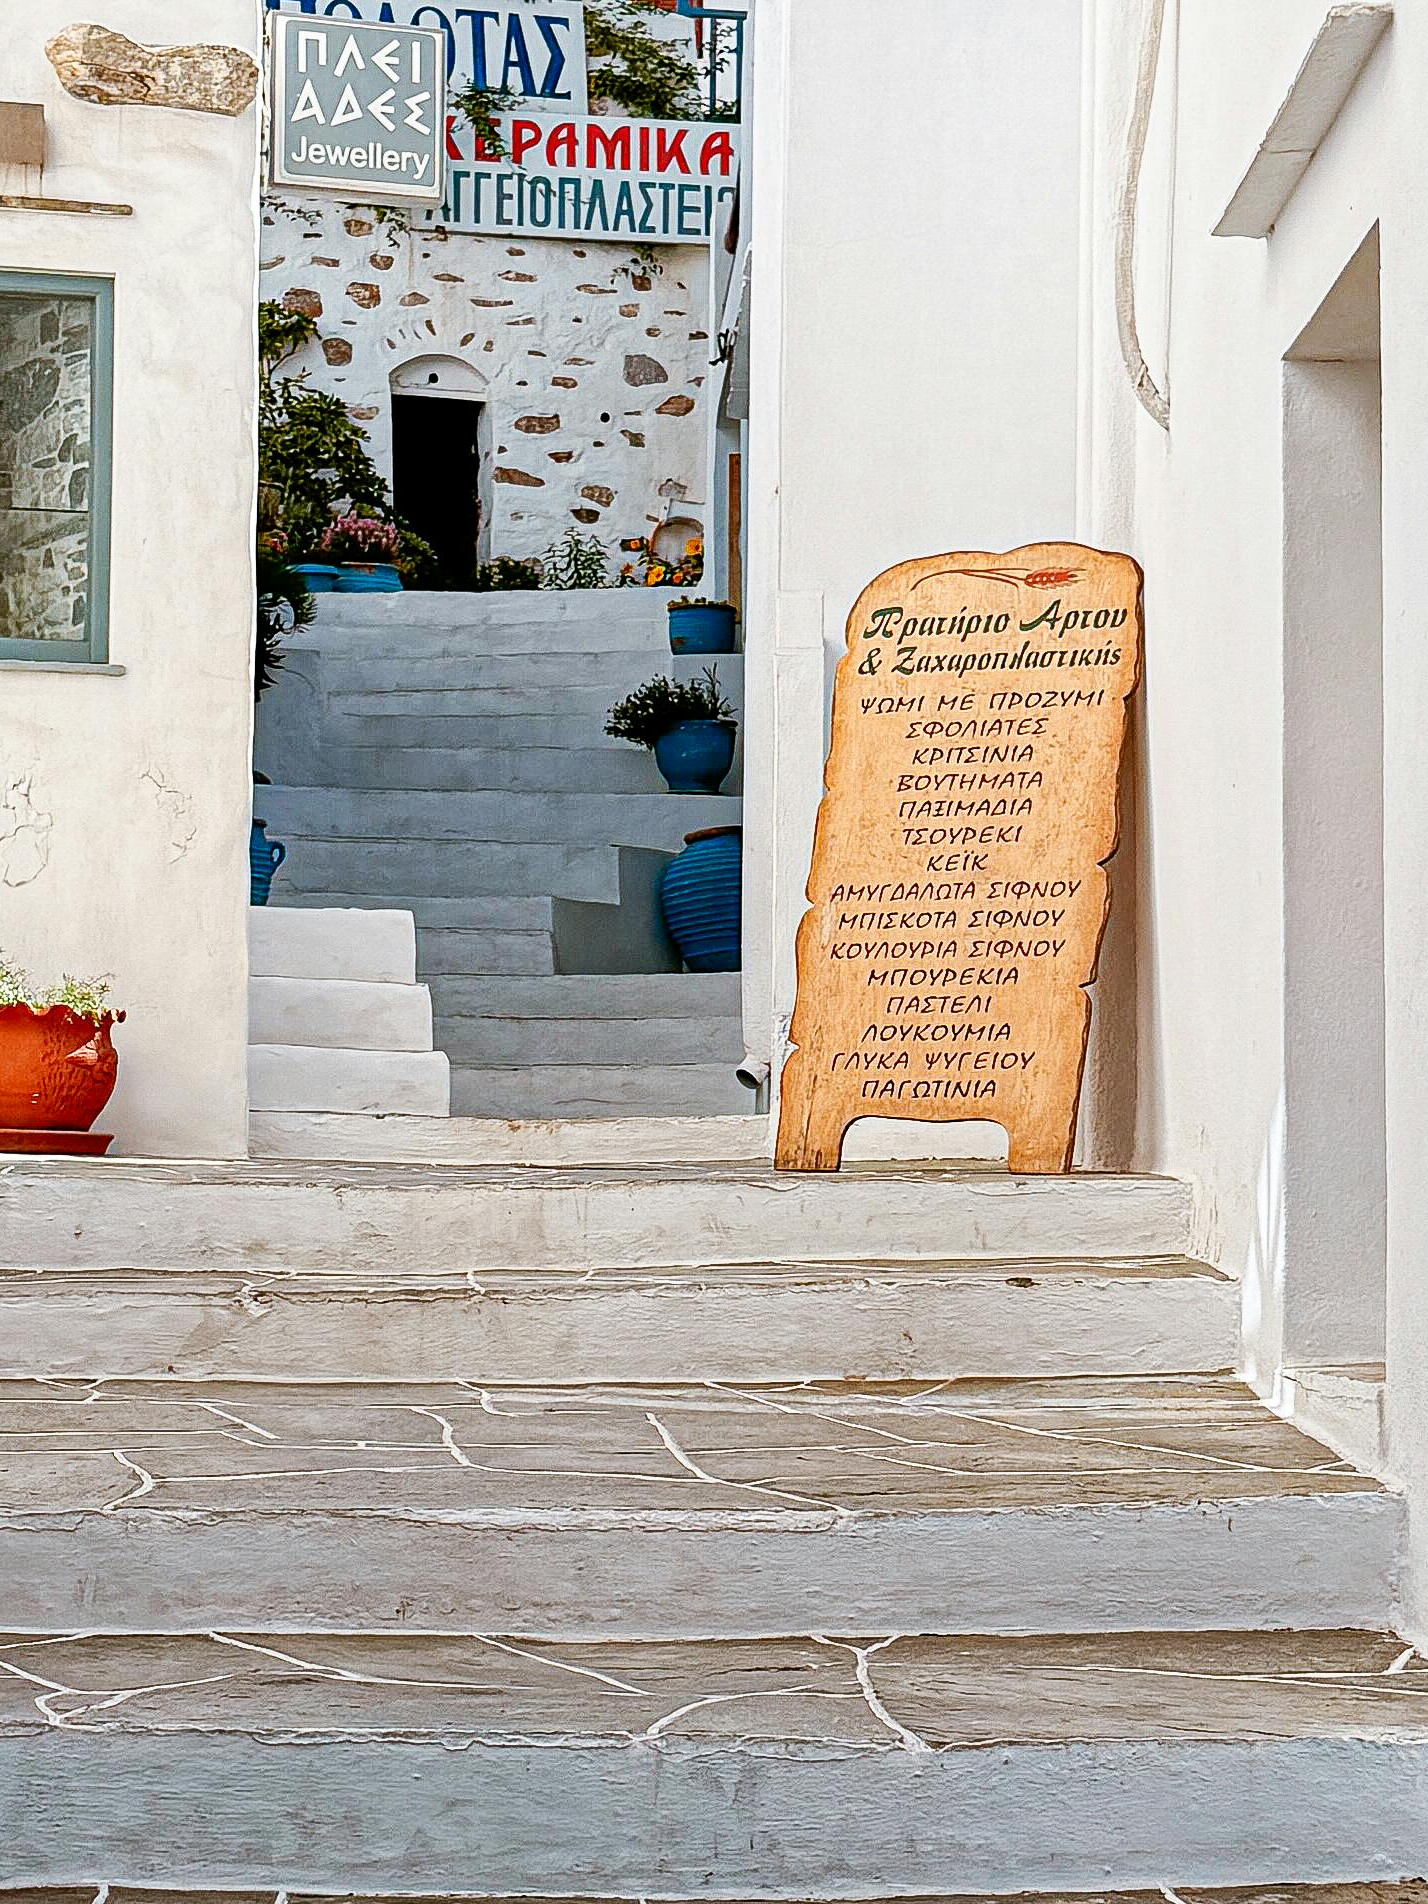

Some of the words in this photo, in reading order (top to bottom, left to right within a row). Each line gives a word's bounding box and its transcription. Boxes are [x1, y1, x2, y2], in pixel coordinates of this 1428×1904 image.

[297, 30, 421, 84] ΠΛΕΙ
[291, 78, 431, 136] ΑΔΕΣ
[291, 135, 430, 180] Jewellery
[863, 606, 1010, 645] Πρατήριο
[1019, 599, 1128, 638] Αρτου
[858, 647, 883, 675] &
[891, 640, 1122, 678] Ζαχαροπλαστικής
[860, 696, 924, 715] ΨΩΜΙ
[937, 693, 975, 711] ΜΕ
[989, 689, 1105, 710] ΠΡΟΖΥΜΙ
[905, 717, 1049, 739] ΣΦΟΛΙΑΤΕΣ
[912, 744, 1034, 766] ΚΡΙΤΣΙΝΙΑ
[896, 771, 1043, 793] ΒΟΥΤΗΜΑΤΑ
[898, 798, 1032, 818] ΠΑΞΙΜΑΔΙΑ
[902, 825, 1022, 846] ΤΣΟΥΡΕΚΙ
[926, 849, 988, 872] ΚΕΪΚ
[830, 881, 975, 903] ΑΜΥΓΔΑΛΩΤΑ
[987, 879, 1081, 899] ΣΙΦΝΟΥ
[838, 911, 957, 930] ΜΠΙΣΚΟΤΑ
[968, 909, 1065, 929] ΣΙΦΝΟΥ
[830, 940, 957, 960] ΚΟΥΛΟΥΡΙΑ
[968, 939, 1065, 958] ΣΙΦΝΟΥ
[868, 967, 1019, 986] ΜΠΟΥΡΕΚΙΑ
[886, 995, 992, 1015] ΠΑΣΤΕΛΙ
[861, 1023, 1011, 1043] ΛΟΥΚΟΥΜΙΑ
[831, 1051, 909, 1071] ΓΛΥΚΑ
[926, 1050, 1036, 1070] ΨΥΓΕΙΟΥ
[862, 1079, 996, 1098] ΠΑΓΩΤΙΝΙΑ
